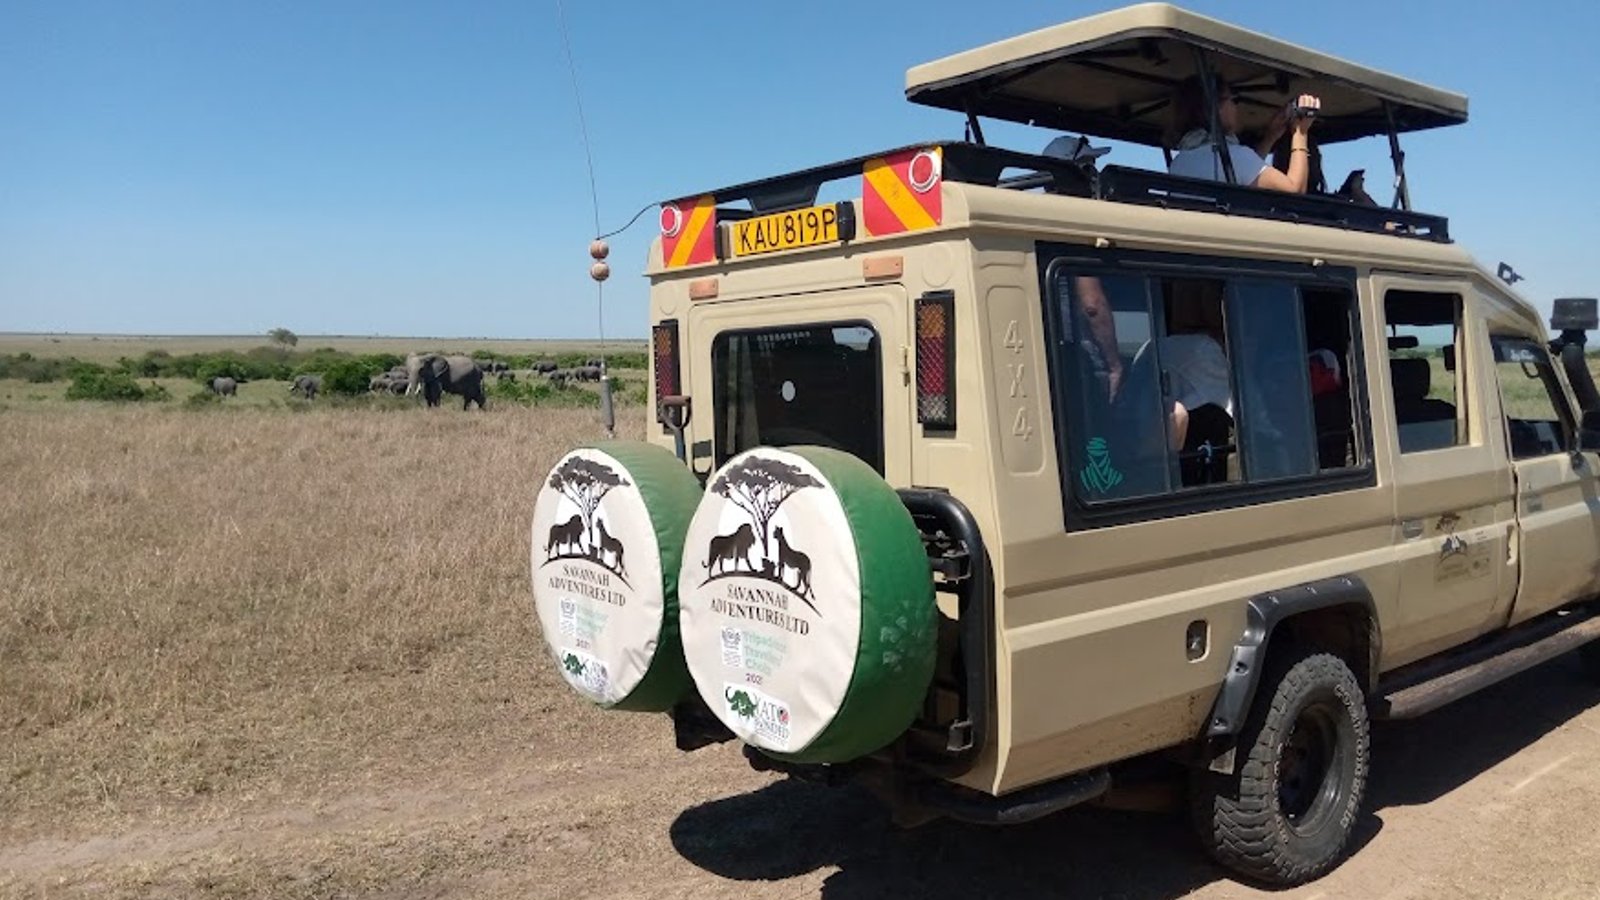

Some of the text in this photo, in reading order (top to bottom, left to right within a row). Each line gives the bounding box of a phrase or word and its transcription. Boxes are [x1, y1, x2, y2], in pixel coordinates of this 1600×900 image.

[563, 563, 610, 587] SAVANNAH
[548, 576, 627, 607] ADVENTURES LTD
[727, 583, 789, 611] SAVANNAH
[710, 598, 810, 636] ADVENTURES LTD
